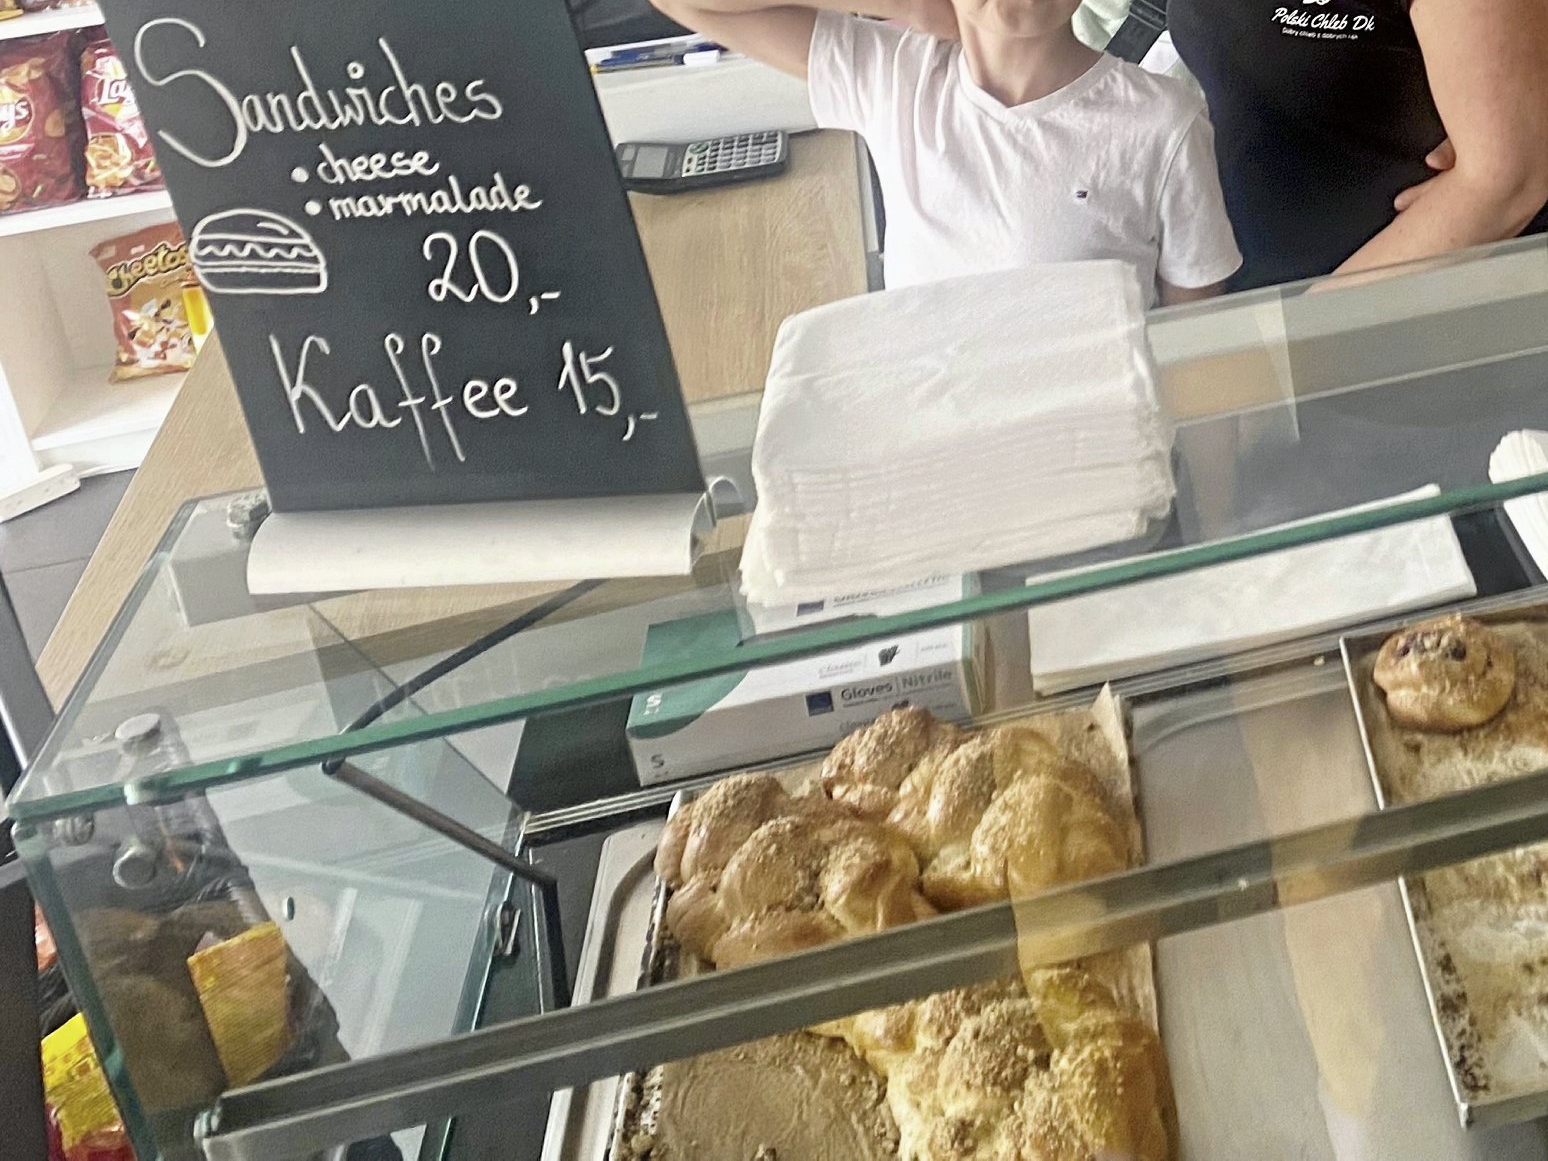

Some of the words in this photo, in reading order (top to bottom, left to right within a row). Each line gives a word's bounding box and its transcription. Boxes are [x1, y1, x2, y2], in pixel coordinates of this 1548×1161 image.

[1271, 6, 1312, 28] Polski
[1311, 12, 1349, 30] Chleb
[1352, 15, 1376, 31] Dk
[134, 17, 504, 167] Sandwiches
[317, 144, 440, 186] cheese
[329, 176, 543, 220] marmalade
[424, 228, 560, 315] 20,-
[269, 332, 528, 472] Kaffee
[557, 340, 658, 442] 15,-
[840, 681, 893, 701] Gloves
[901, 669, 952, 688] Nitrile
